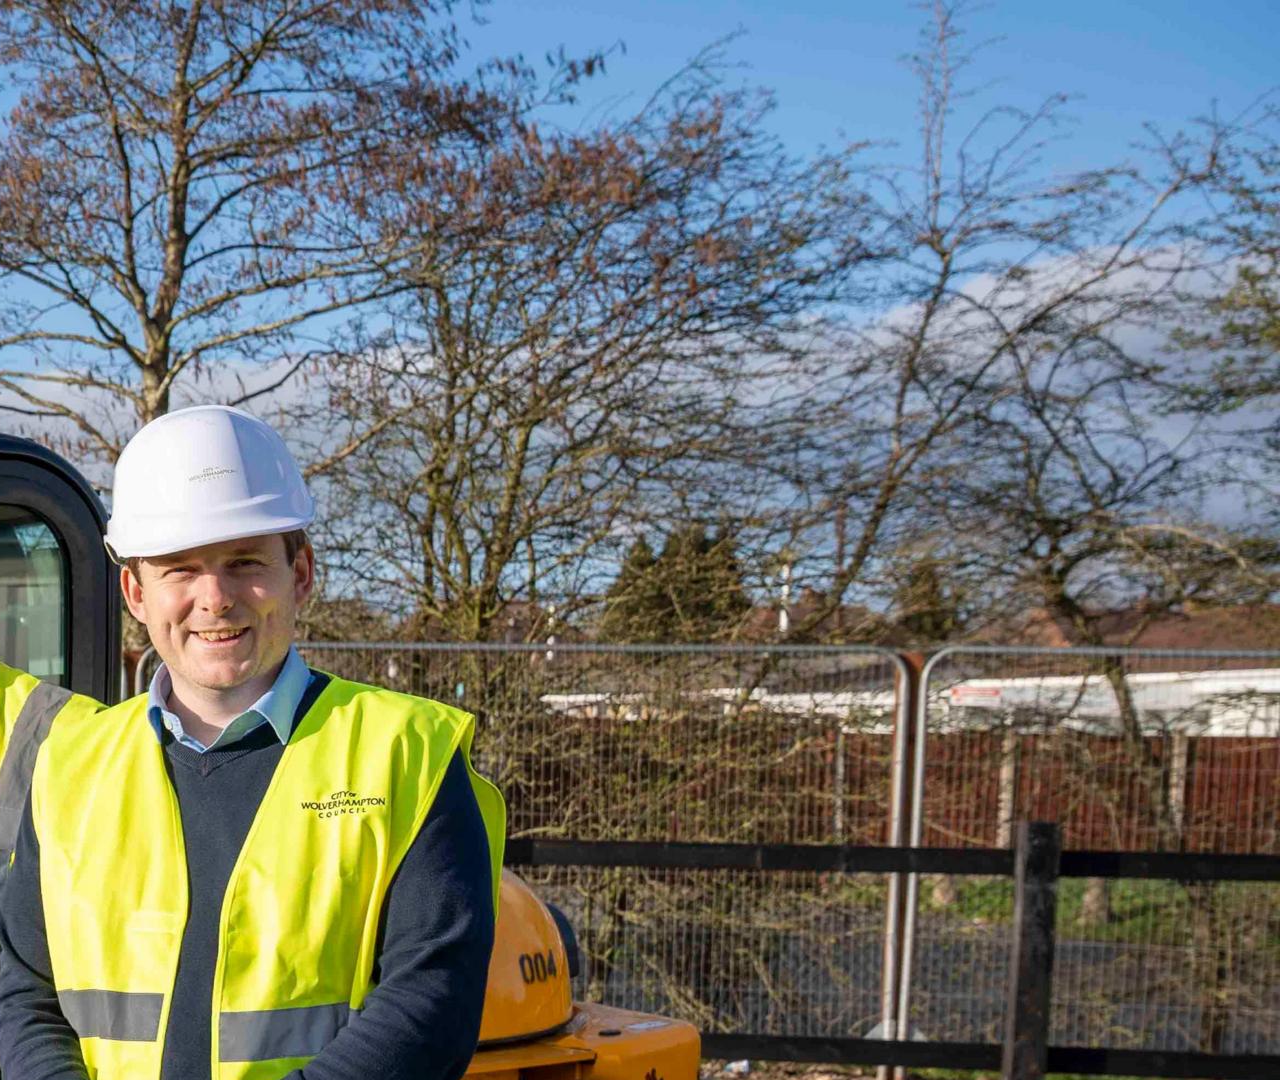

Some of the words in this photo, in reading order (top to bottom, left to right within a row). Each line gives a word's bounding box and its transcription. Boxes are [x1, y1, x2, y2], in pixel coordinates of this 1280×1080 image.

[331, 791, 349, 800] CITY
[301, 797, 385, 810] WOLVERHAMPTON
[319, 808, 367, 819] COUNCIL
[519, 949, 557, 984] 004
